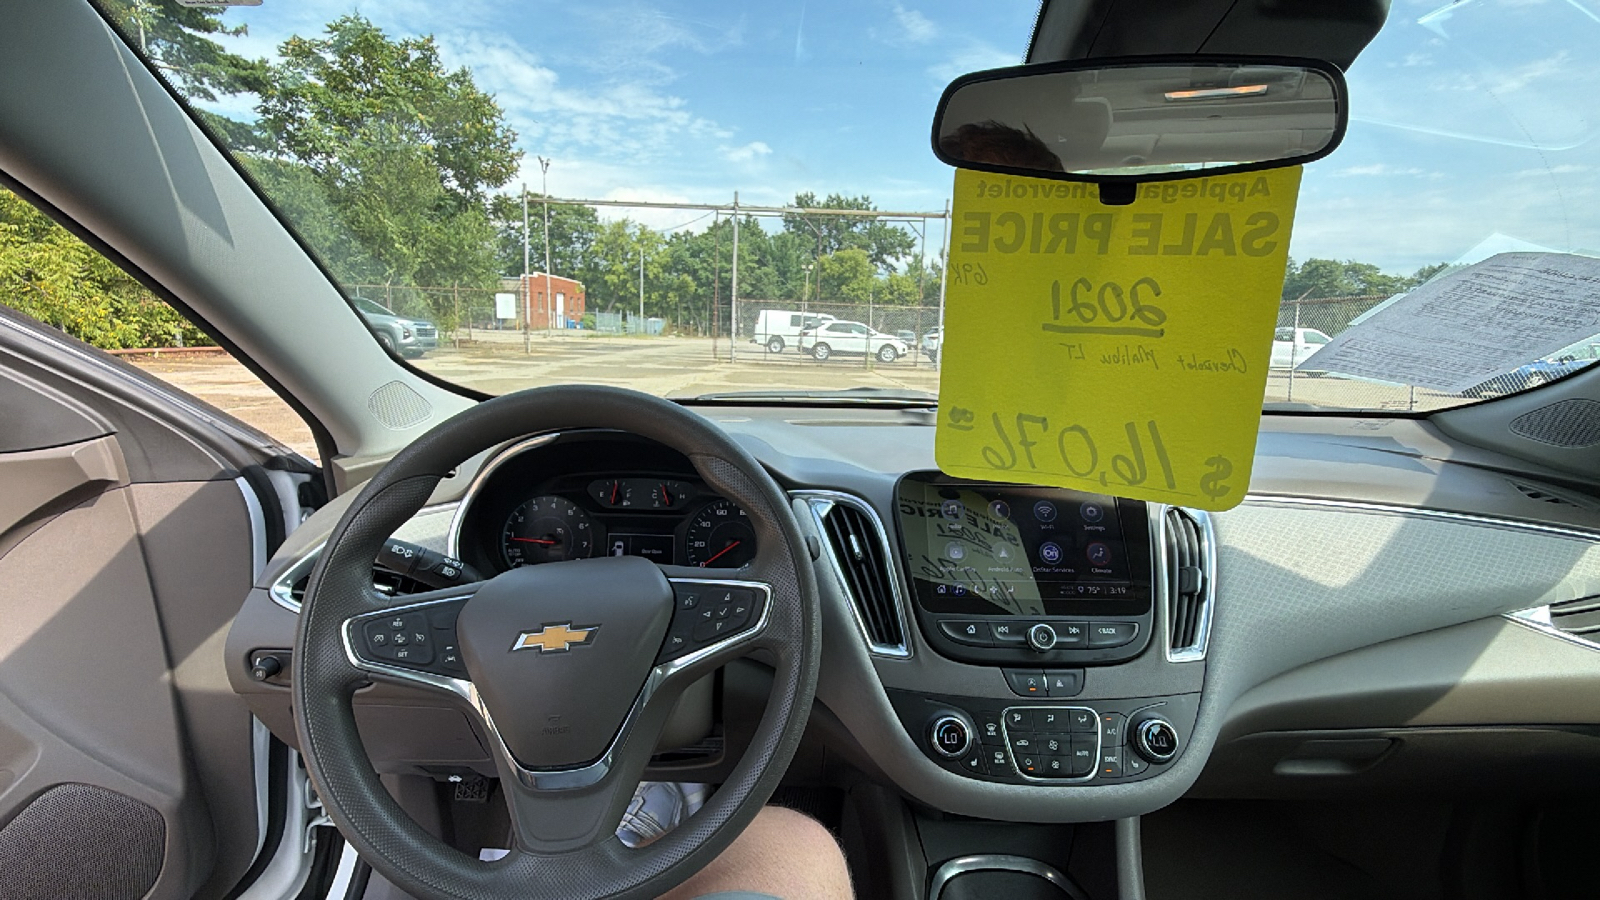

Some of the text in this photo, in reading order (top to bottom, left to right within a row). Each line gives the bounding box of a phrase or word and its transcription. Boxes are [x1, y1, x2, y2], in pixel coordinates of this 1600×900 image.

[1082, 524, 1106, 532] Settings
[1109, 586, 1127, 595] 3:19
[1106, 727, 1117, 735] A/C
[944, 732, 958, 744] LO
